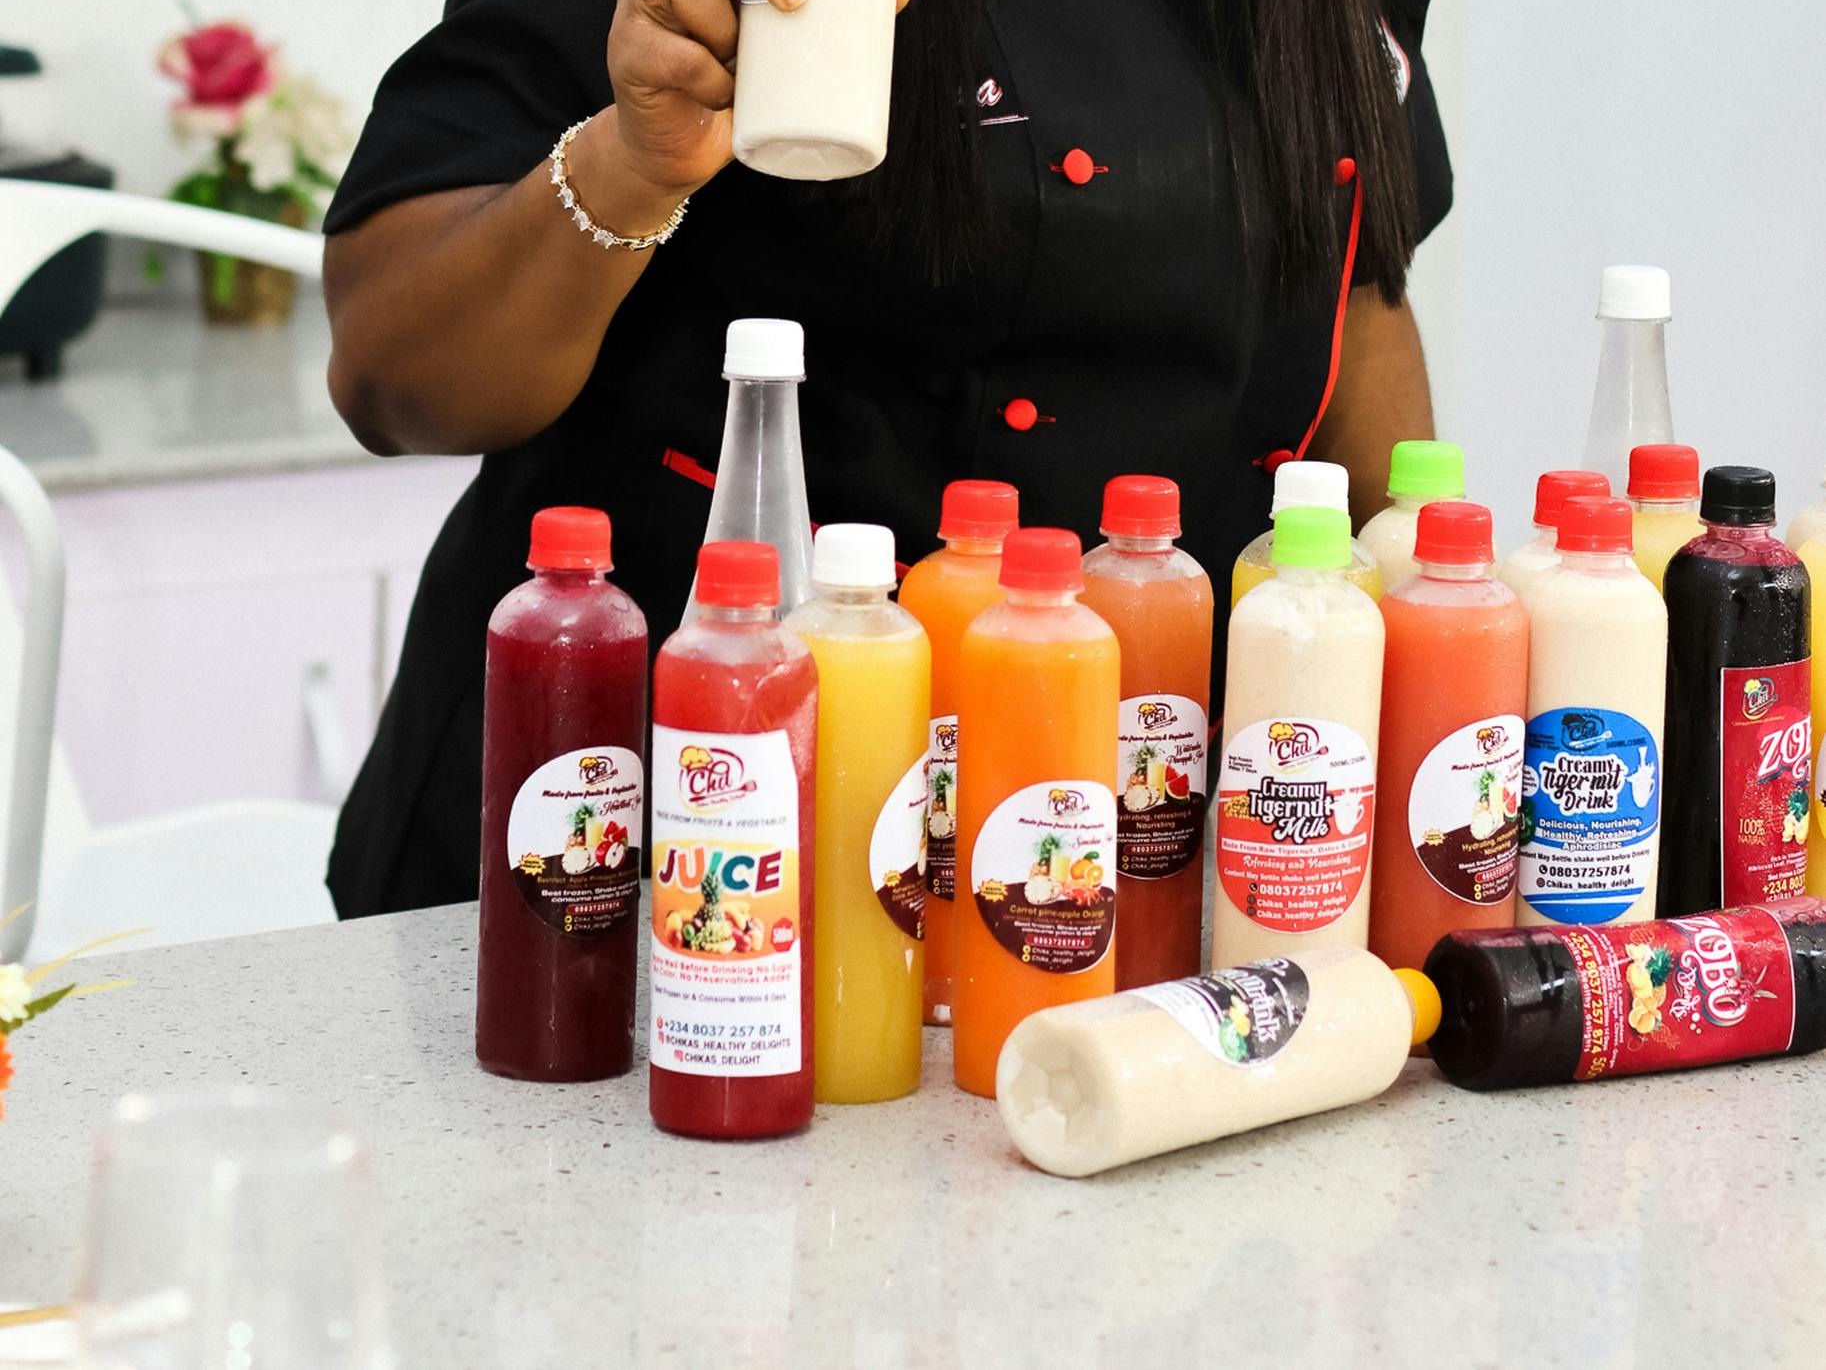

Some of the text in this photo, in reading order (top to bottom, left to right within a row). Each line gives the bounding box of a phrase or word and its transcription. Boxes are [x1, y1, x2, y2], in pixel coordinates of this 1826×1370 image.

[1558, 756, 1614, 774] Creamy
[1262, 778, 1326, 801] Creamy
[1542, 764, 1624, 800] Tigernut
[1248, 790, 1334, 824] Tigernut
[1564, 790, 1614, 811] Drink
[1272, 815, 1330, 844] Milk
[1540, 818, 1588, 830] Delicious,
[1740, 818, 1766, 836] 100%
[1542, 830, 1586, 842] Healthy,
[1562, 842, 1622, 852] Aphrodisiac
[1243, 855, 1352, 871] Refreshing and Nourishing
[1538, 852, 1550, 862] May
[1552, 854, 1572, 862] Settle
[1574, 854, 1598, 862] shake
[1600, 854, 1610, 862] well
[1612, 852, 1630, 860] before
[659, 846, 782, 893] JUICE
[1224, 868, 1245, 878] Content
[1246, 870, 1258, 880] May
[1282, 872, 1304, 882] shake
[1305, 872, 1320, 881] well
[1320, 870, 1340, 880] before
[1550, 864, 1630, 878] 08037257874
[1260, 880, 1342, 896] 08037257874
[1762, 878, 1787, 894] +234
[1010, 904, 1037, 914] Carrot
[680, 962, 710, 973] Before
[712, 966, 754, 976] Drinking
[756, 966, 770, 974] No
[1667, 916, 1748, 1020] ZOBO
[680, 972, 790, 984] No Preservatives Added
[1569, 932, 1604, 1054] +234 8037 257 874
[1235, 974, 1282, 1043] Drink
[665, 1020, 781, 1037] +234 8037 257 874
